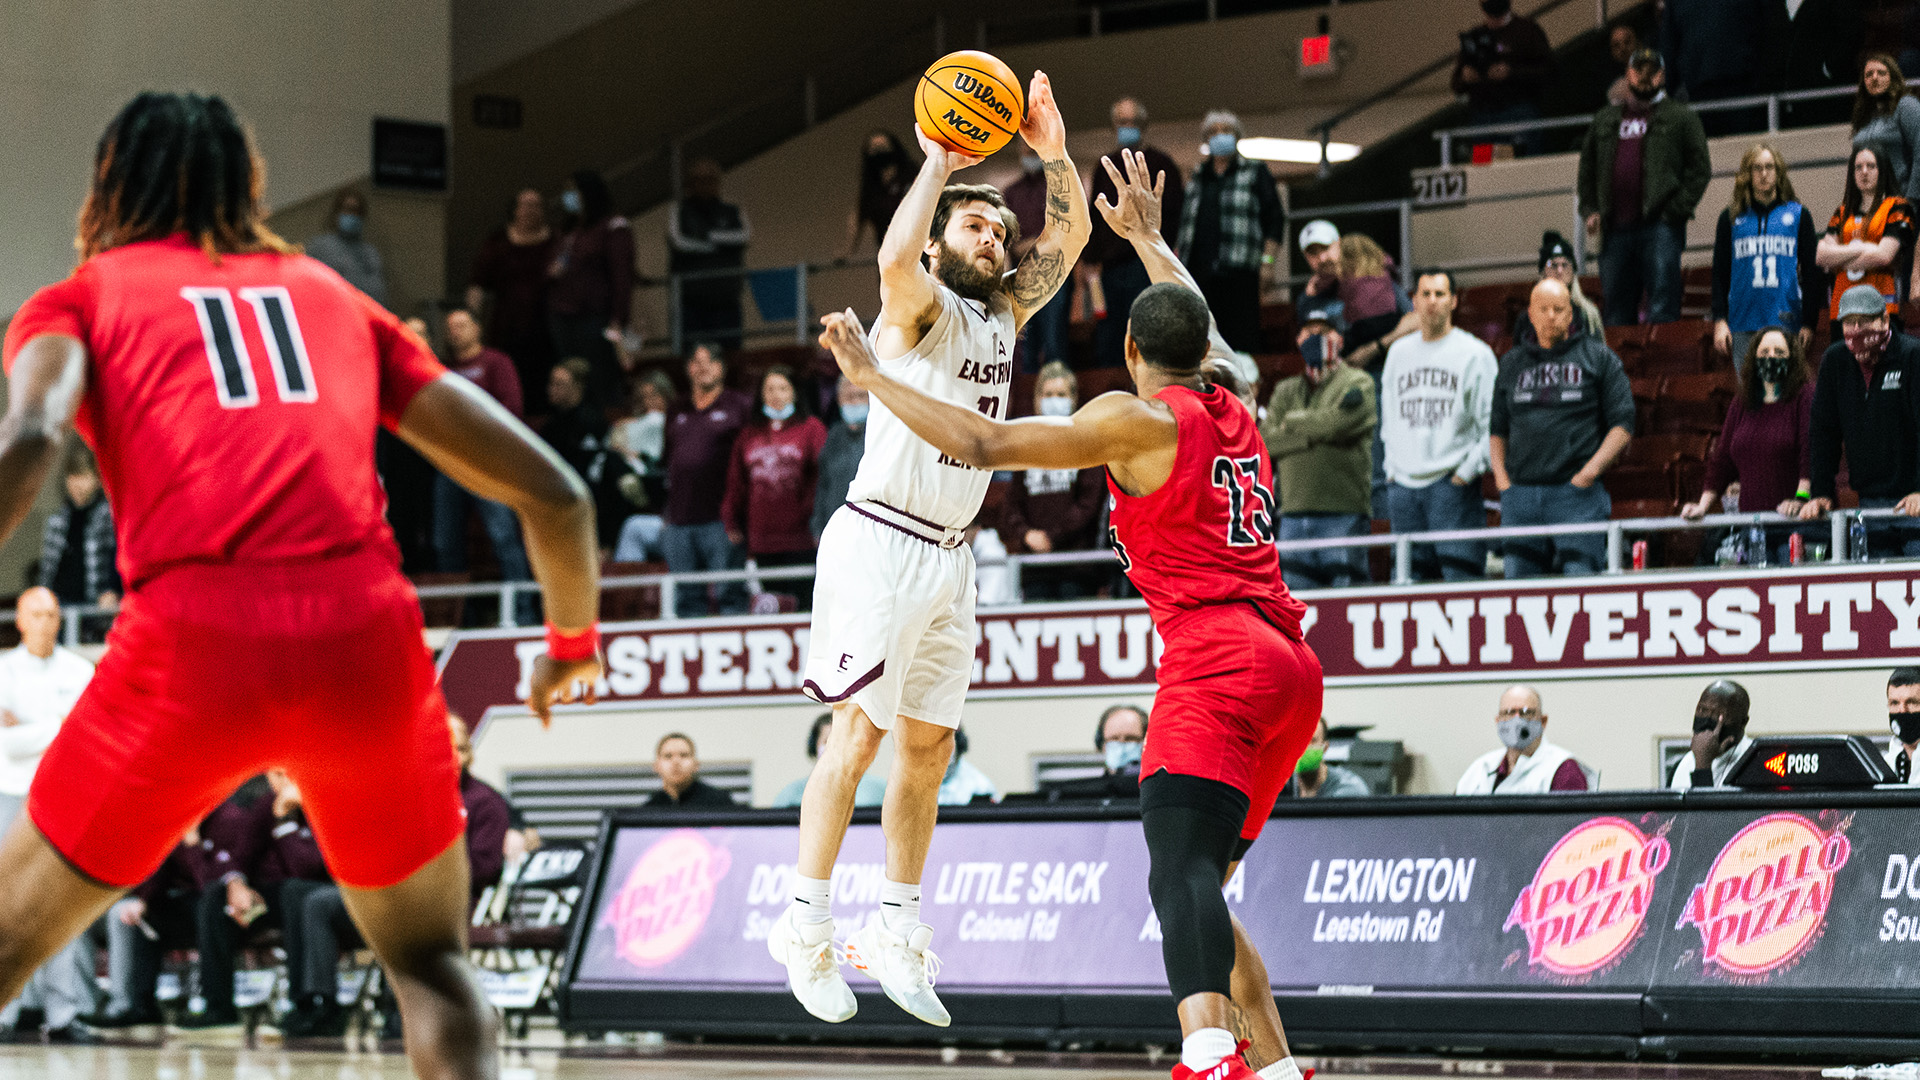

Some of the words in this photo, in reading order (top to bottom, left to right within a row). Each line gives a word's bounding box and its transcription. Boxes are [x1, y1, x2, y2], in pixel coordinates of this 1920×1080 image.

[953, 71, 1013, 124] Wilson
[942, 108, 992, 145] NCAA
[1411, 175, 1464, 205] 202
[1734, 234, 1797, 260] KENTUCKY
[1752, 254, 1779, 289] 11
[179, 286, 319, 410] 11
[957, 358, 1012, 386] EASTRN
[1398, 366, 1459, 397] EASTERN
[1212, 453, 1276, 547] 23
[515, 628, 811, 701] STER
[1347, 580, 1920, 669] UNIVERSITY
[838, 653, 853, 671] E
[1787, 753, 1819, 775] POSS
[747, 863, 887, 905] DOTOW
[934, 862, 1028, 904] LITTLE
[1027, 861, 1109, 904] SACK
[1303, 857, 1476, 903] LEXINGTON
[1502, 836, 1671, 933] APOLLO
[1675, 831, 1851, 931] APOLLO
[958, 910, 1031, 942] Colonel
[1029, 910, 1061, 942] Rd
[1313, 909, 1410, 942] Leestown
[1412, 908, 1445, 942] Rd
[1528, 884, 1643, 966] PIZZA
[1703, 879, 1822, 964] PIZZA
